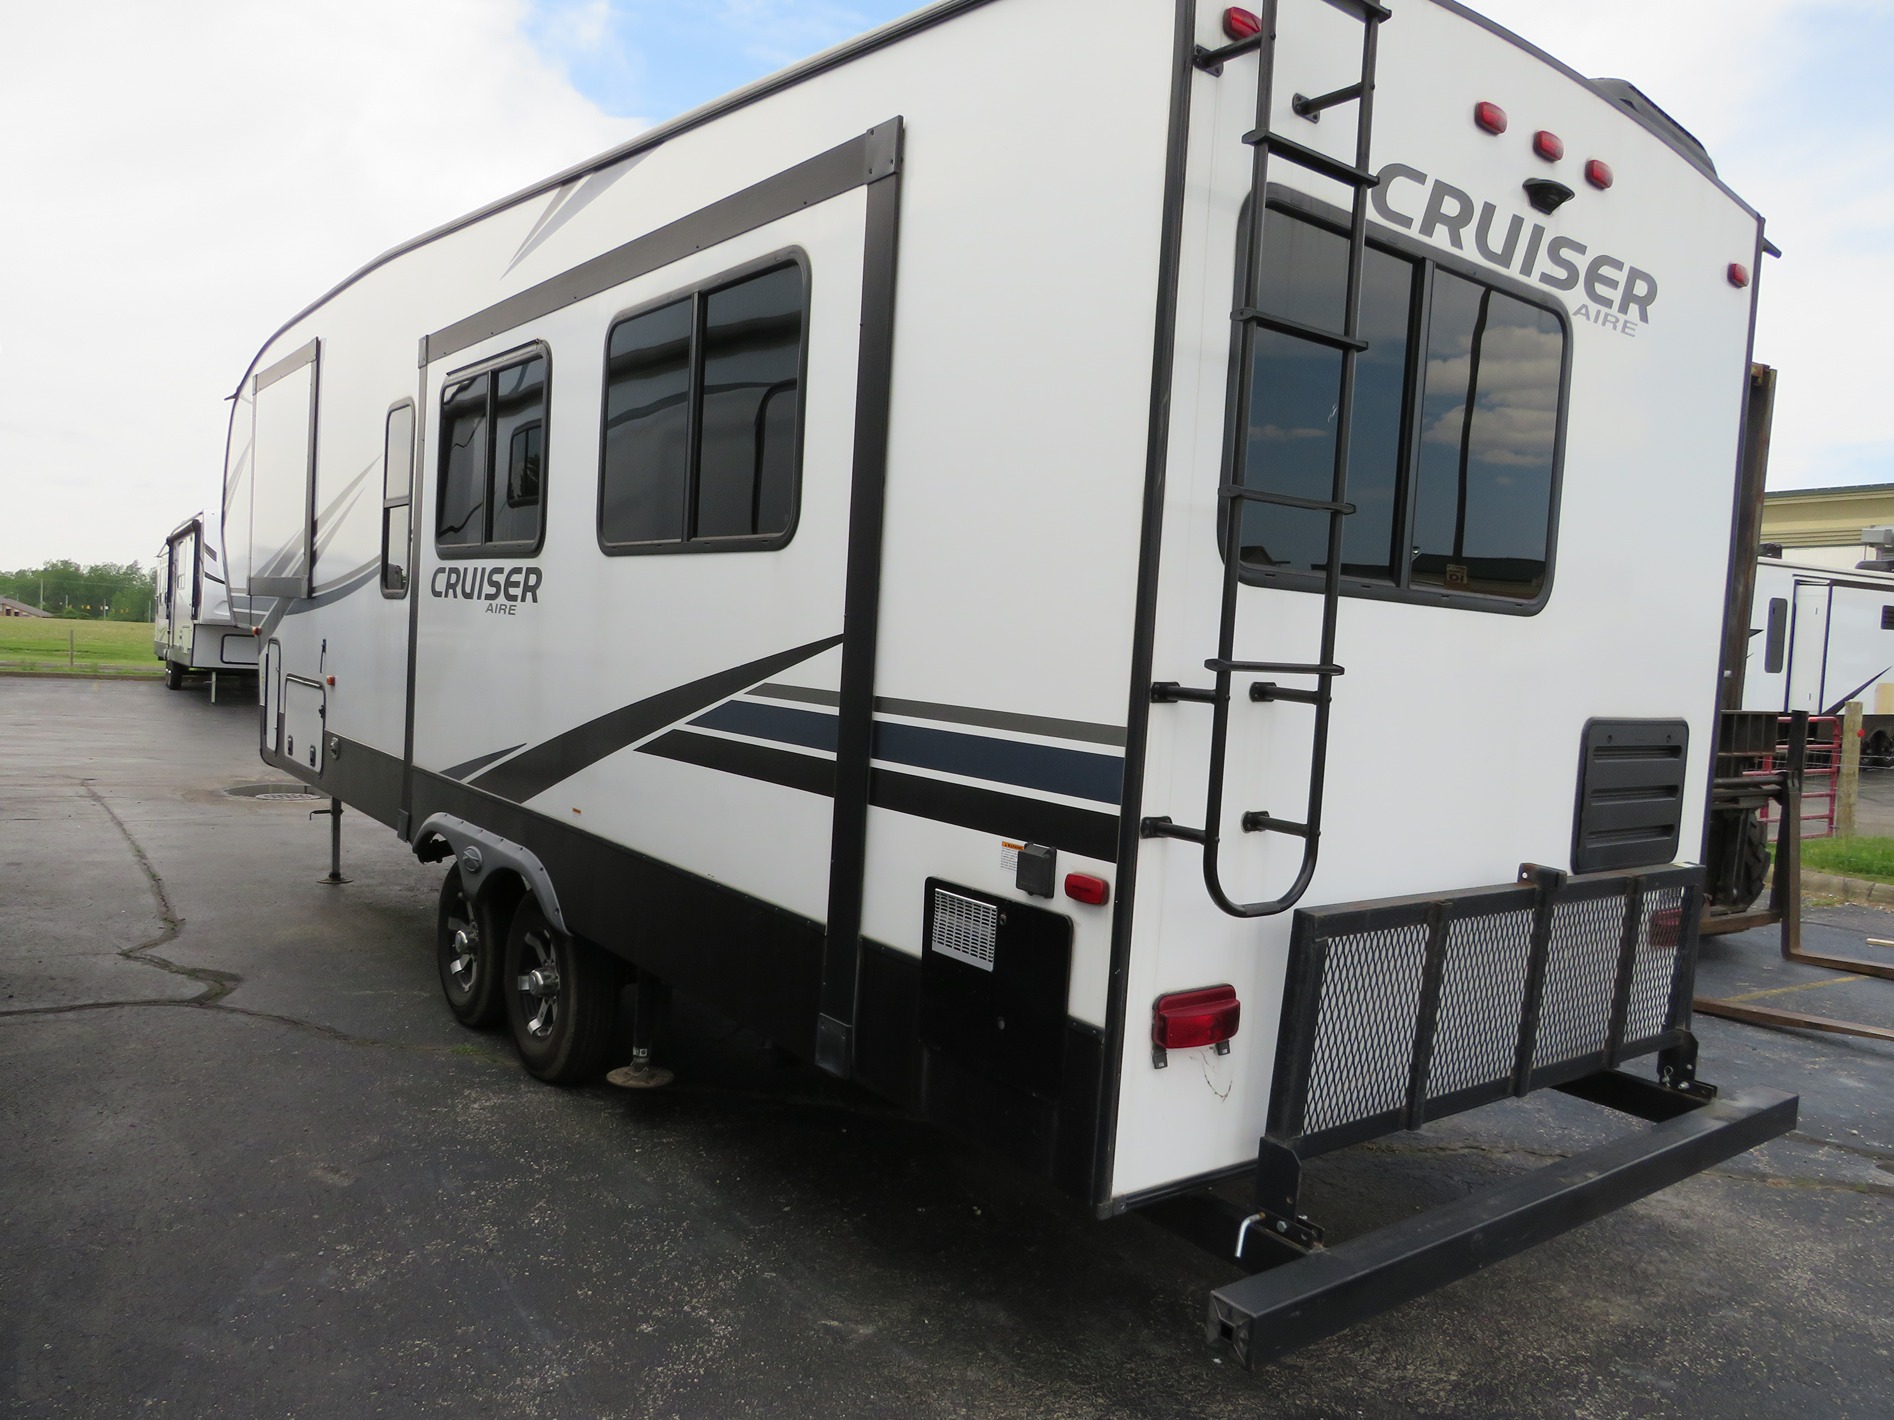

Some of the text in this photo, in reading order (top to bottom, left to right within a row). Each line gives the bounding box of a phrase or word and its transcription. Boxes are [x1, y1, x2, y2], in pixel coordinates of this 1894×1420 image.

[1371, 163, 1658, 324] CRUISER
[1572, 303, 1638, 337] AIRE
[431, 567, 543, 603] CRUISER
[485, 603, 517, 615] AIRE
